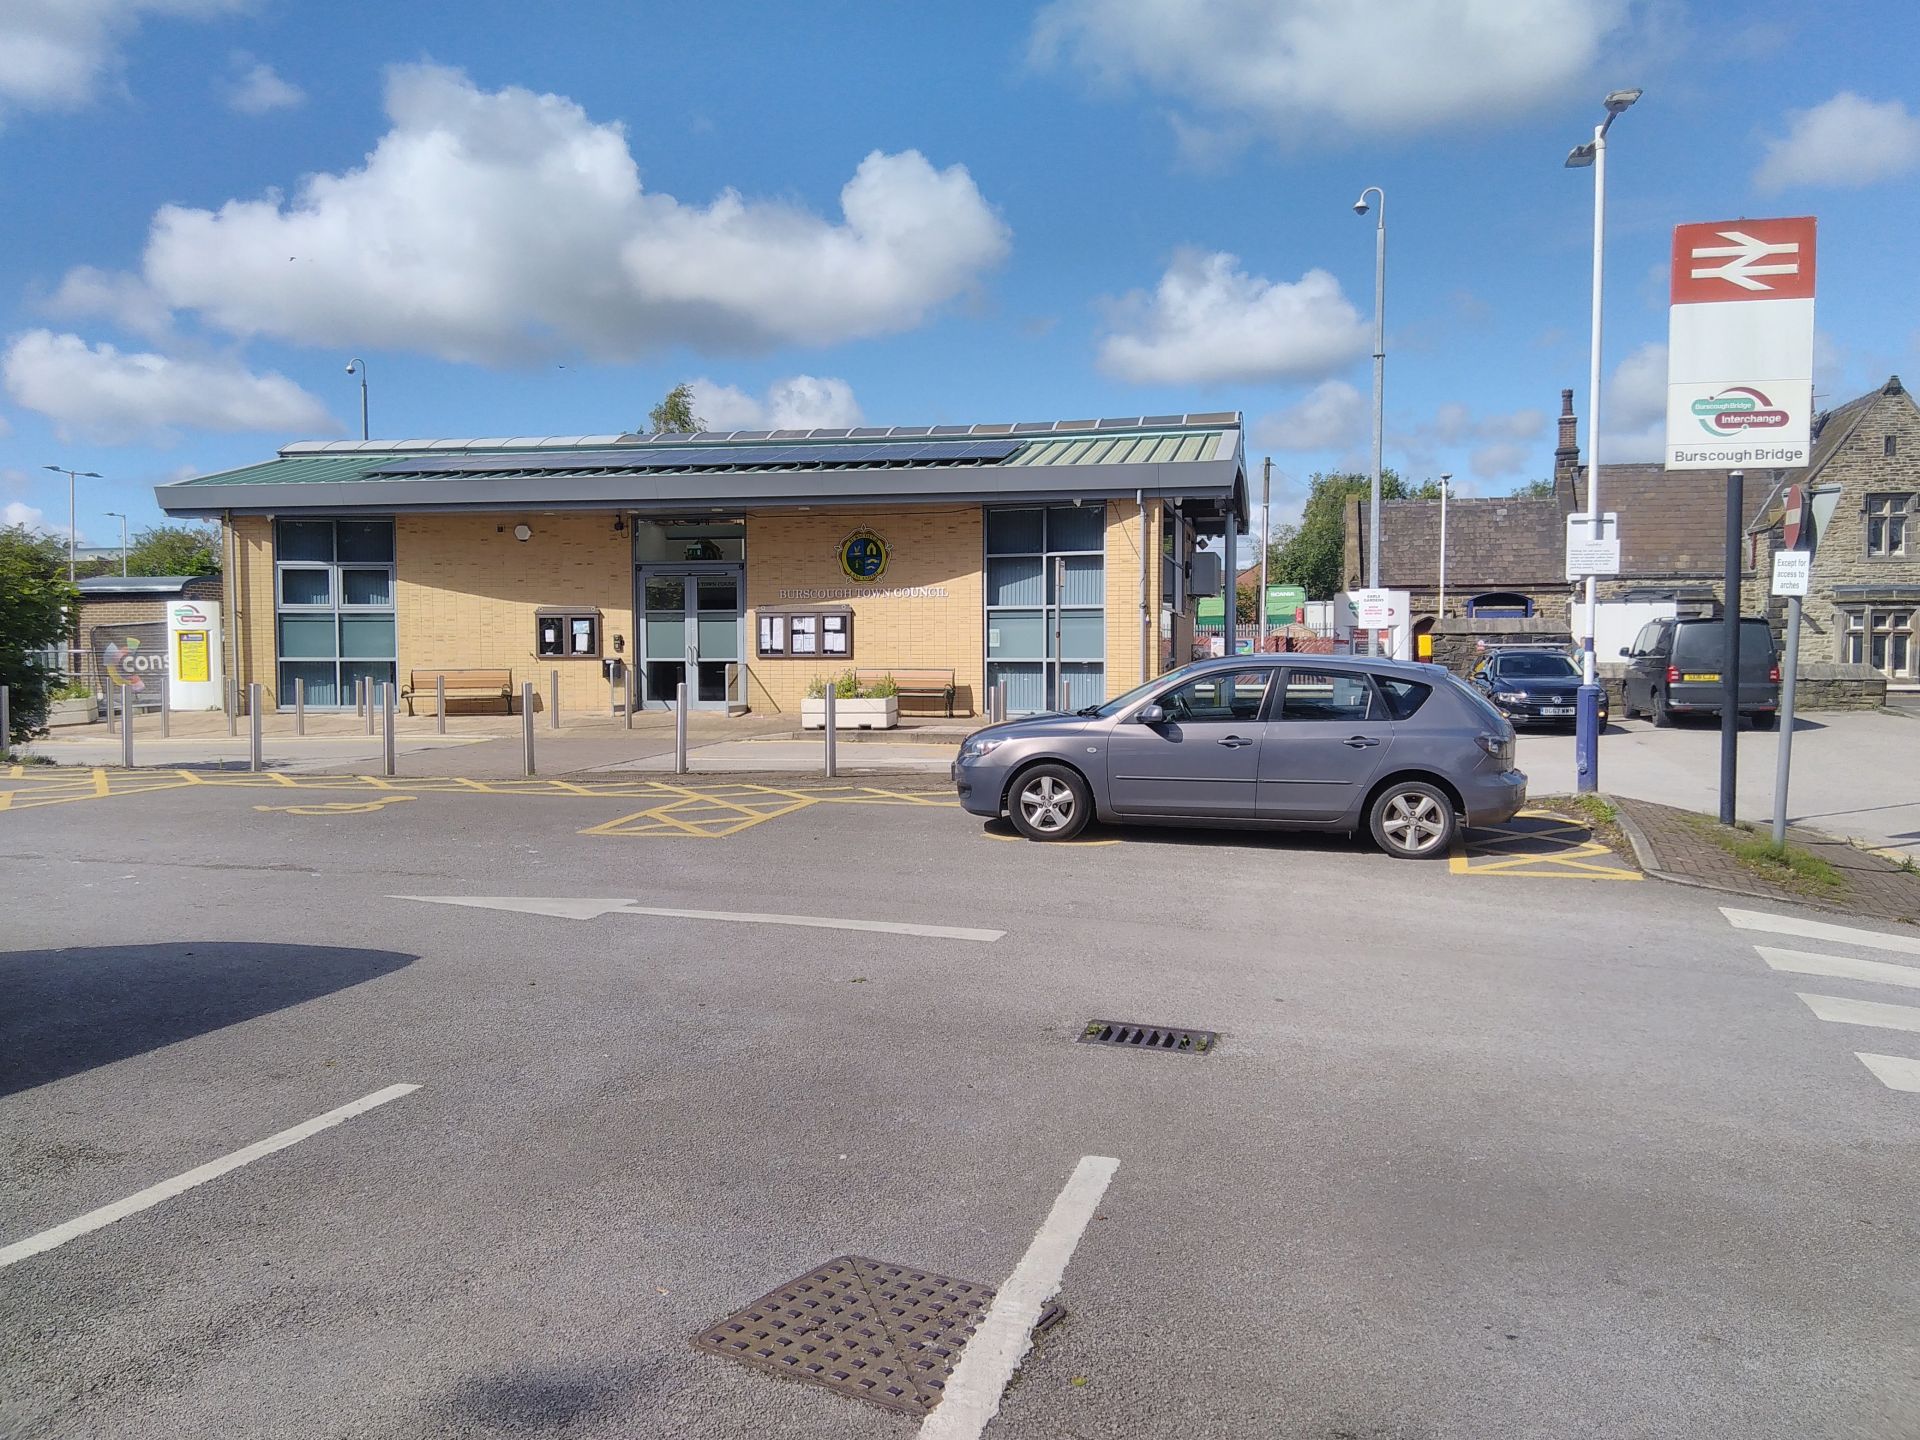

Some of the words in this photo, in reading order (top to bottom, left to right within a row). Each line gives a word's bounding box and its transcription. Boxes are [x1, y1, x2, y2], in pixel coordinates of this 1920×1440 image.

[1721, 414, 1782, 424] Interchange
[1674, 450, 1752, 463] Burscough
[1755, 448, 1803, 462] Bridge
[1777, 559, 1797, 568] Except
[1798, 558, 1807, 567] for
[779, 589, 851, 599] BURSCOUGH
[856, 588, 890, 598] TOWN
[893, 587, 949, 598] COUNCIL
